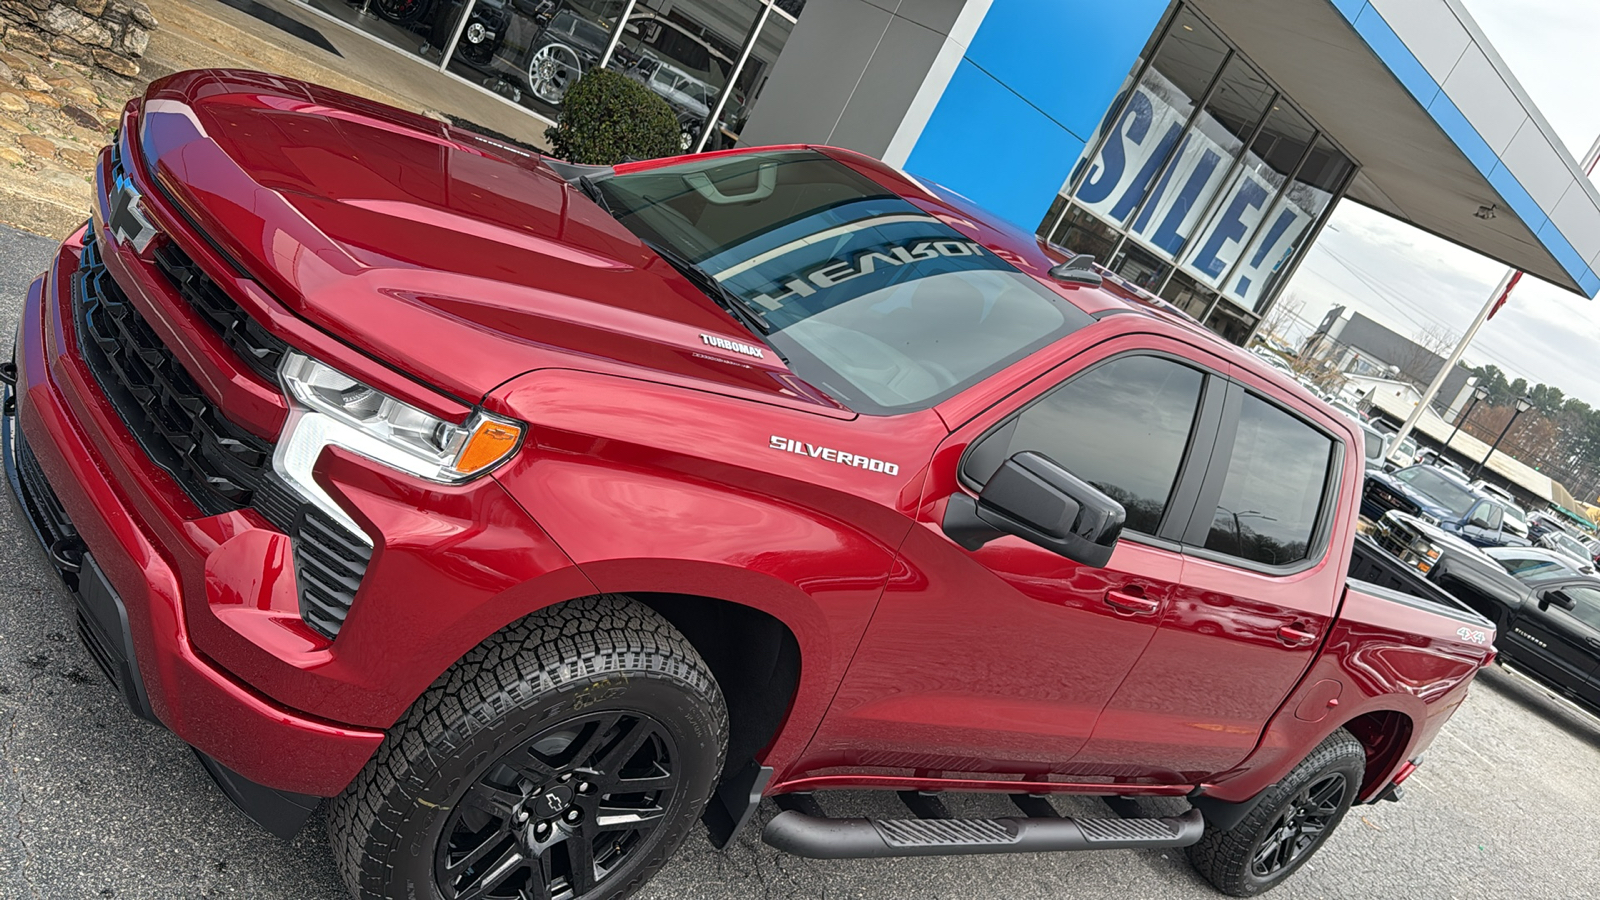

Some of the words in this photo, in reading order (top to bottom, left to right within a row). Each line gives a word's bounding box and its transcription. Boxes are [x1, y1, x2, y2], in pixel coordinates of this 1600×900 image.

[1070, 89, 1297, 298] SALE!
[699, 333, 764, 359] TURBOMAX
[769, 434, 899, 476] SILVERADO
